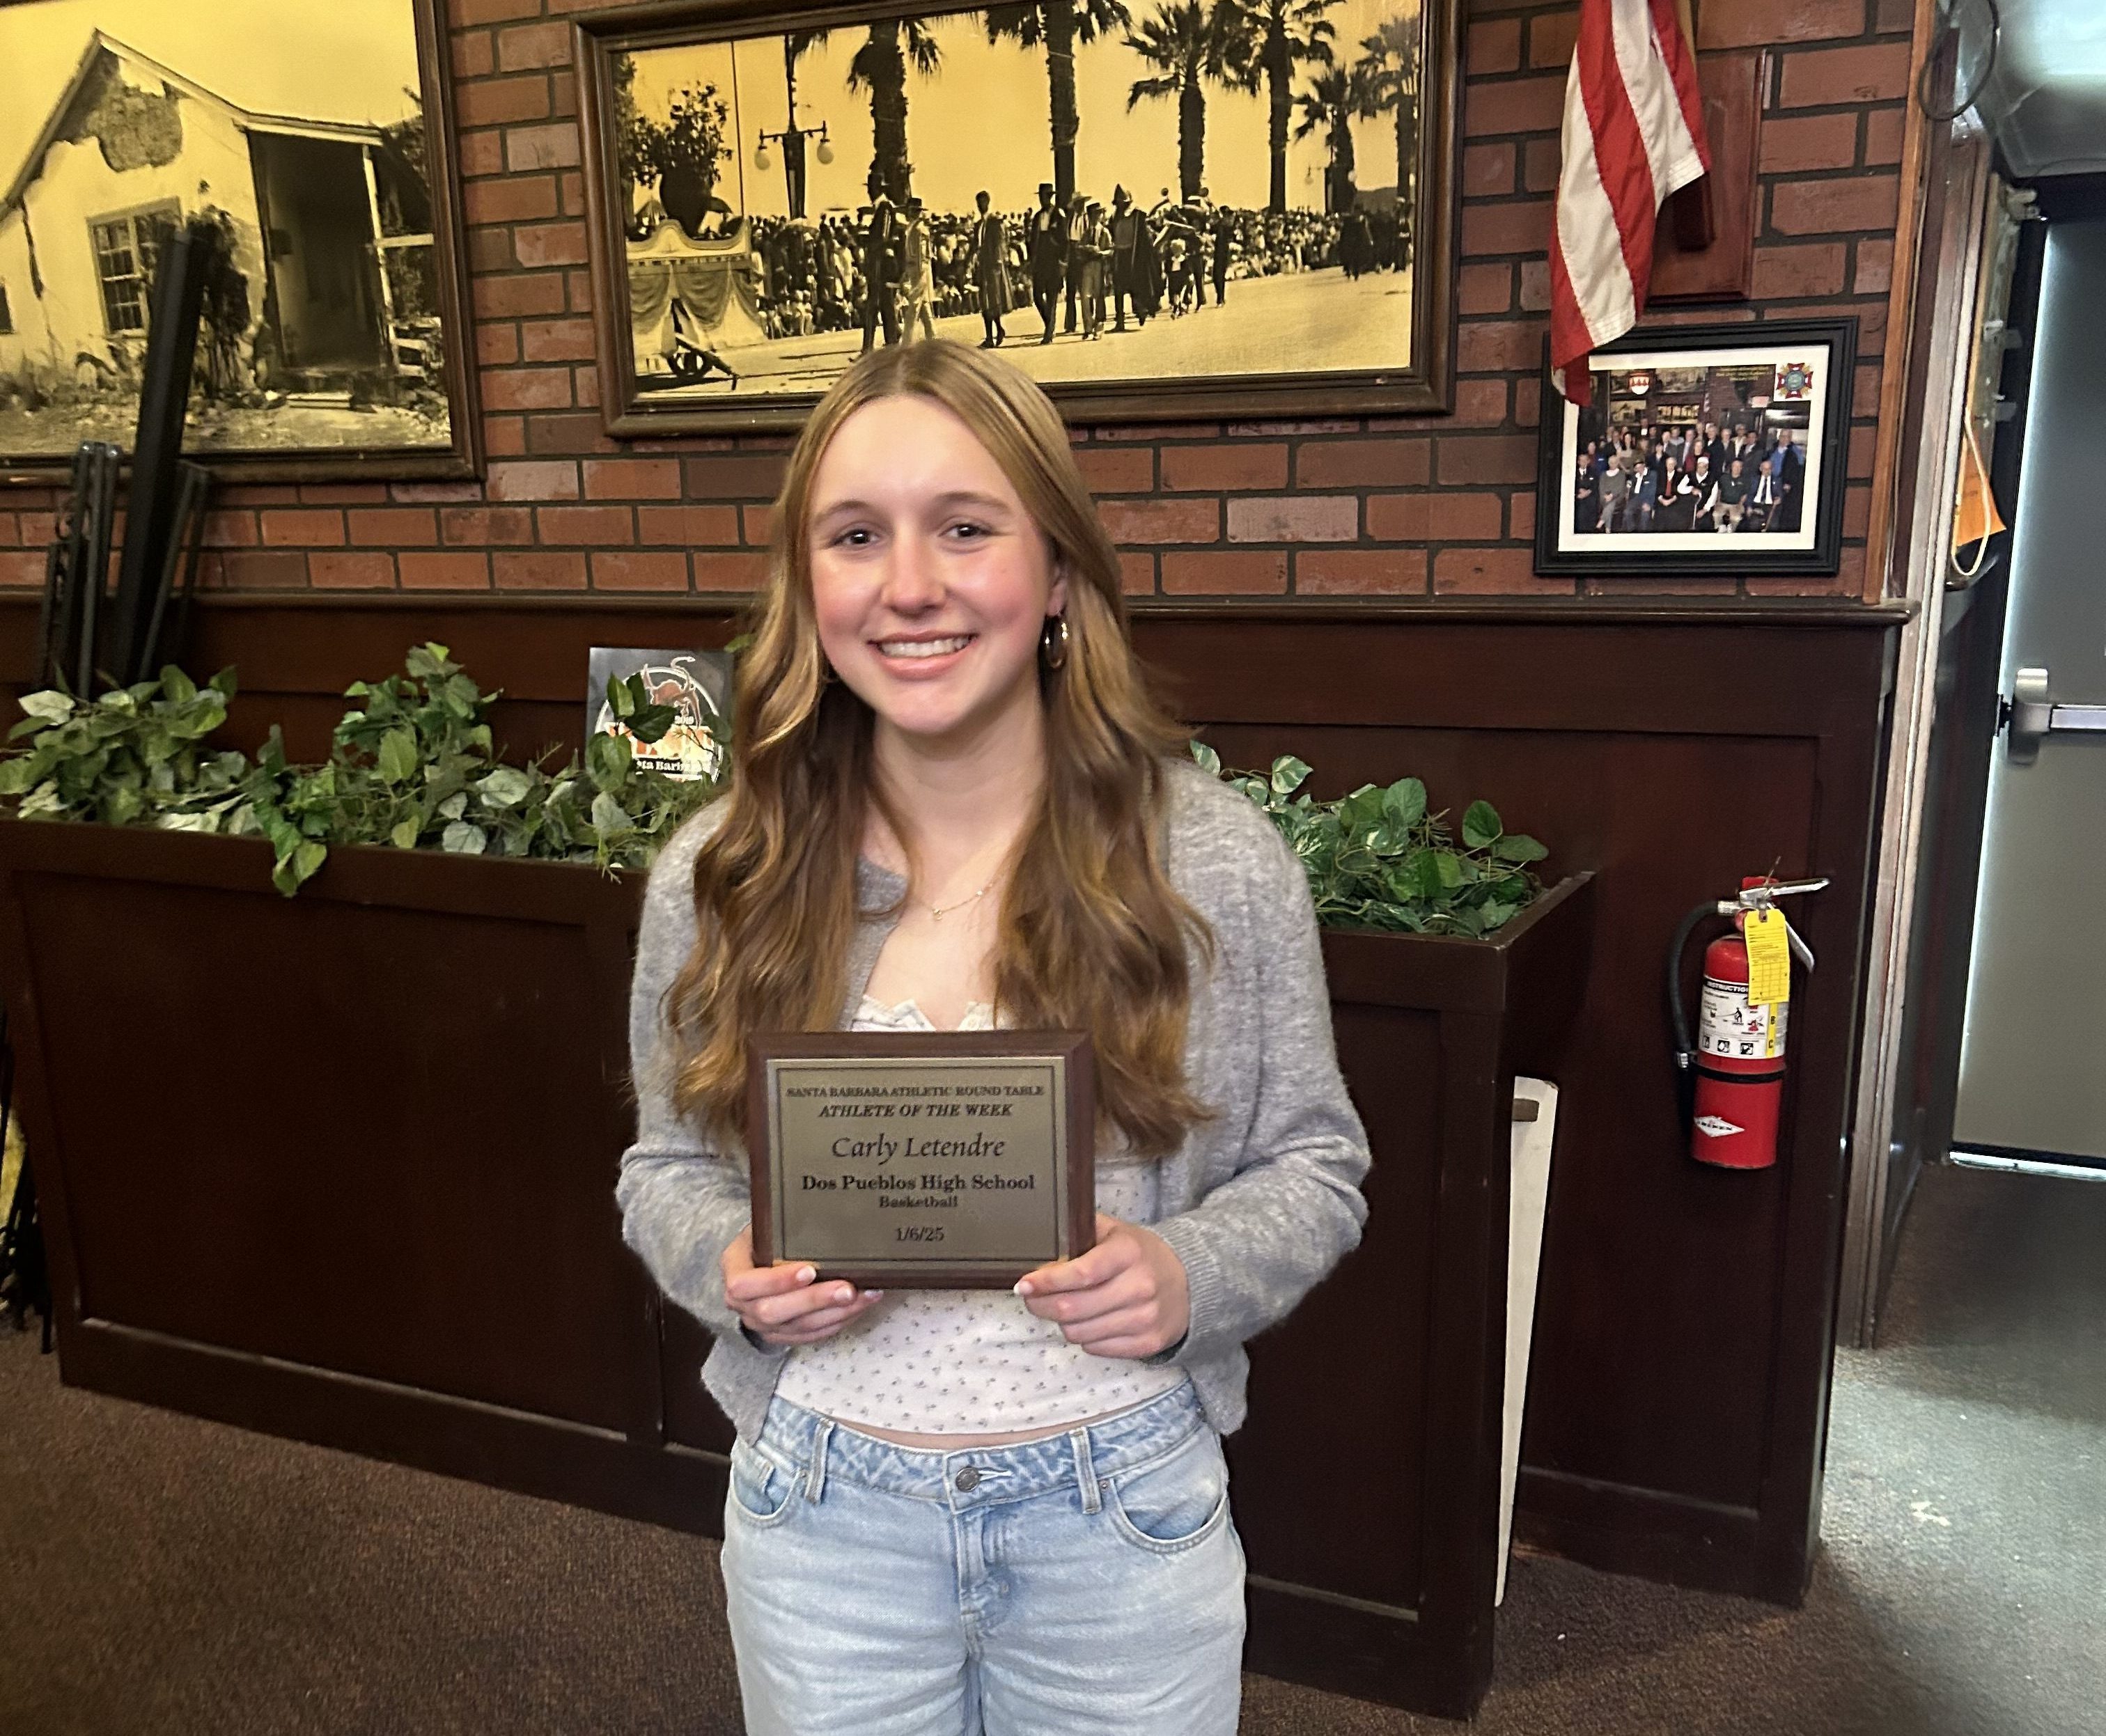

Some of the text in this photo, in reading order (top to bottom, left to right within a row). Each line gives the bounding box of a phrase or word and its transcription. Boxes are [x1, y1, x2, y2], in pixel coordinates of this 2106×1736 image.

[786, 1086, 1044, 1097] SANTA BARBARA ATHLETIC ROUND TABLE
[818, 1103, 1013, 1118] ATHLETE OF THE WEEK
[832, 1132, 1007, 1166] Carly Letendre
[801, 1173, 1036, 1194] Dos Pueblos High School
[878, 1195, 958, 1209] Basketball
[896, 1226, 945, 1242] 1/6/25
